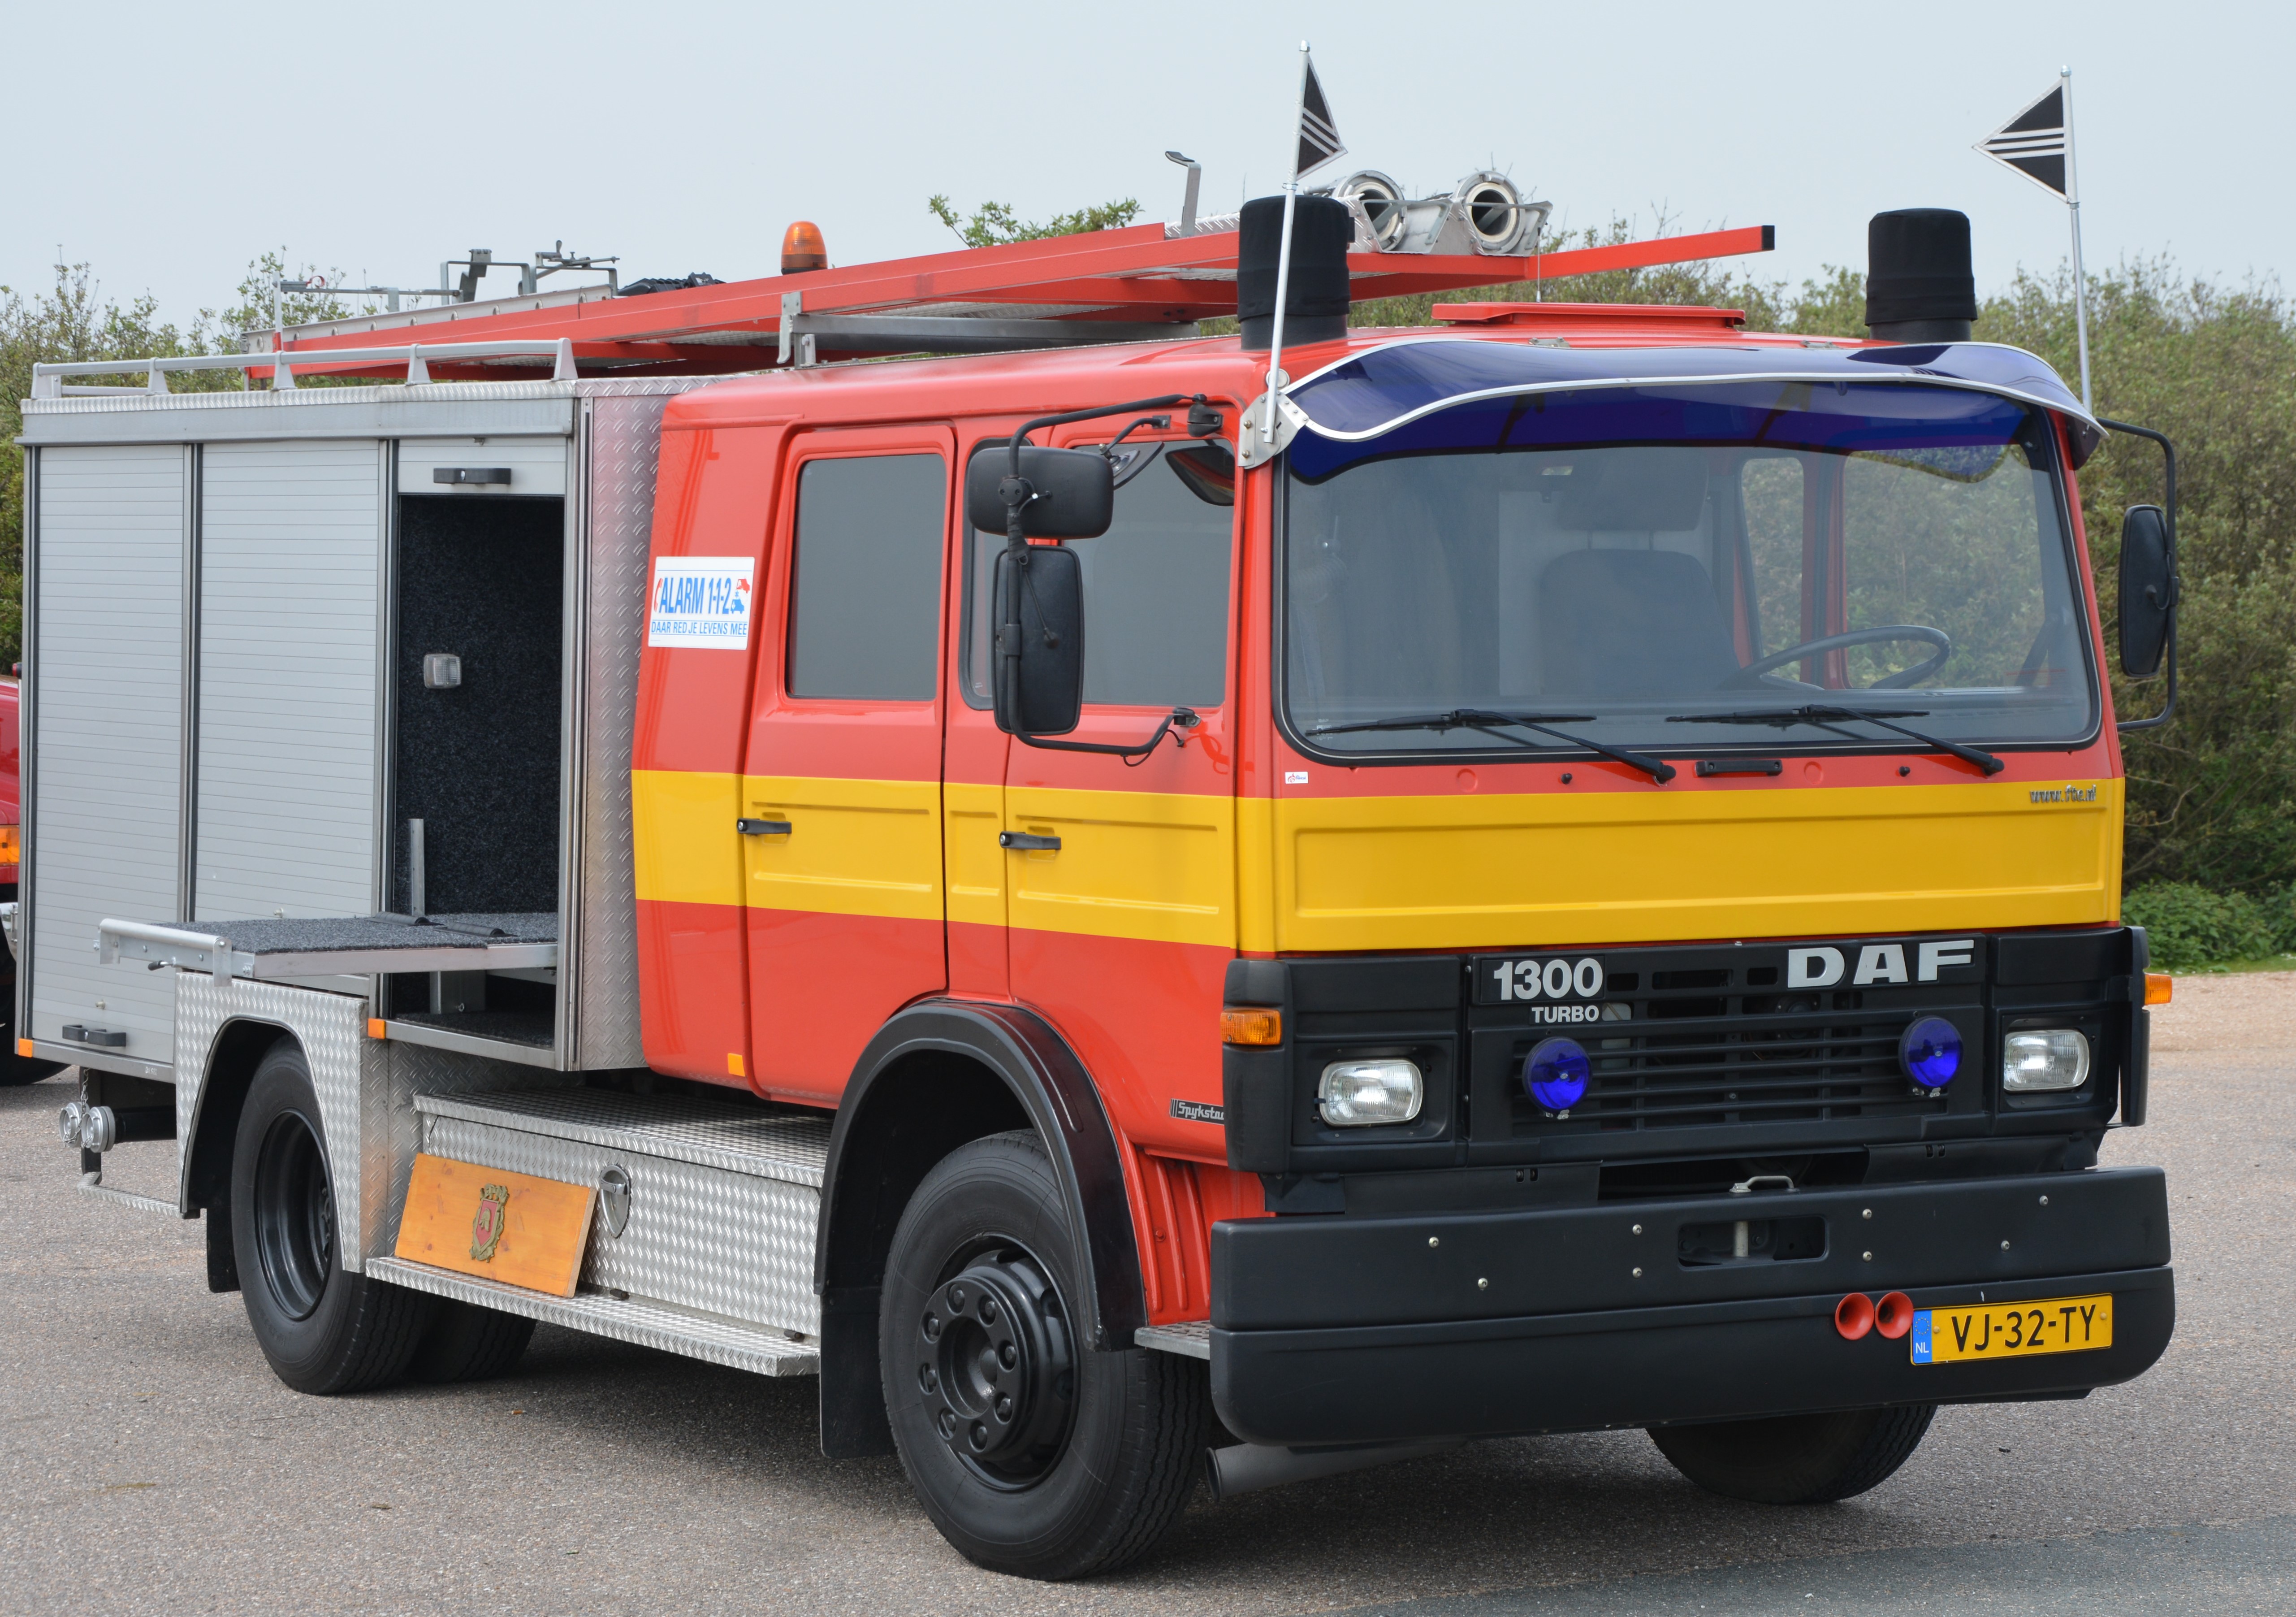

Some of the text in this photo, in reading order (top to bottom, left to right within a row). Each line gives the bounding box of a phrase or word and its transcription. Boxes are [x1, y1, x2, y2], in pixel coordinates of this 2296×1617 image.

[659, 577, 732, 614] ALARM 1-1-2
[651, 621, 747, 635] DAAR RED JE LEVENS MEE
[1494, 958, 1603, 1000] 1300
[1788, 940, 1974, 988] DAF
[1531, 1005, 1599, 1023] TURBO
[1950, 1304, 2096, 1352] VJ-32-TY
[1915, 1342, 1929, 1354] NL
